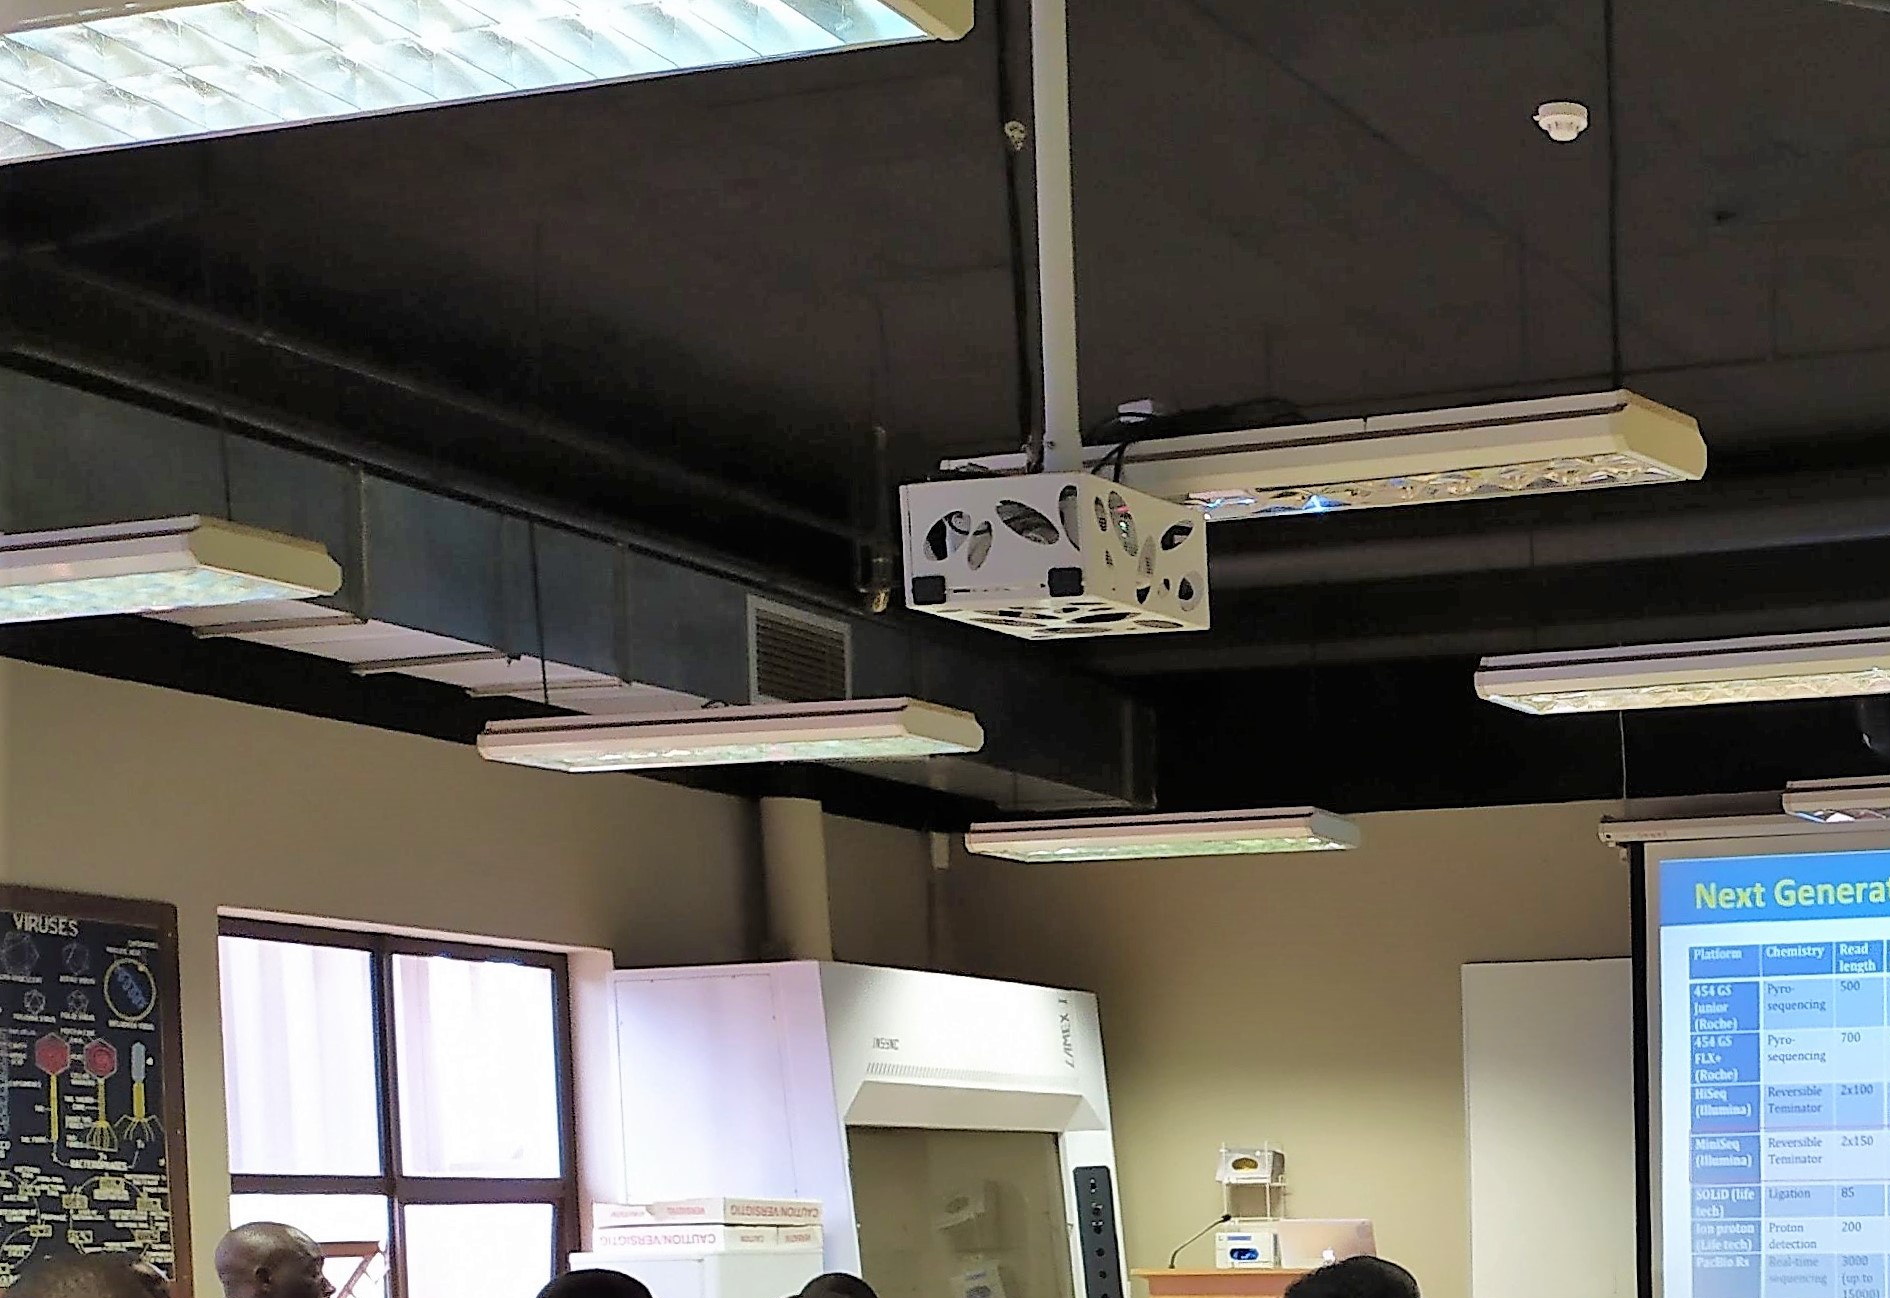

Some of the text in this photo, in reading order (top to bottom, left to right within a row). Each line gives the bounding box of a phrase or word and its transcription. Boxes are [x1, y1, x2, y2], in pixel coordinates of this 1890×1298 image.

[1695, 883, 1766, 910] Next
[13, 912, 79, 937] VIRUSES
[1693, 948, 1743, 960] Platform
[1766, 945, 1825, 959] Chemistry
[1840, 943, 1869, 955] Read
[1840, 960, 1876, 974] length
[1767, 984, 1795, 997] Pyro-
[1840, 980, 1861, 991] 500
[1694, 1002, 1729, 1015] Junior
[1767, 1000, 1826, 1013] sequencing
[1695, 1017, 1738, 1032] (Roche)
[1767, 1035, 1796, 1048] Pyro-
[1841, 1032, 1861, 1043] 700
[1767, 1051, 1826, 1064] sequencing
[1695, 1068, 1738, 1083] (Roche)
[1695, 1088, 1727, 1102] HiSeq
[1768, 1086, 1822, 1098] Reversible
[1841, 1084, 1874, 1096] 2x100
[1695, 1103, 1752, 1118] (Illumina)
[1768, 1102, 1822, 1113] Teminator
[1695, 1138, 1741, 1152] MiniSeq
[1768, 1137, 1823, 1149] Reversible
[1841, 1135, 1873, 1147] 2x150
[1768, 1153, 1823, 1165] Teminator
[1768, 1187, 1811, 1201] Ligation
[1841, 1187, 1855, 1198] 85
[1768, 1222, 1804, 1233] Proton
[1841, 1221, 1862, 1232] 200
[1768, 1238, 1817, 1250] detection
[1769, 1255, 1819, 1267] Real-time
[1841, 1256, 1869, 1267] 3000
[1769, 1273, 1827, 1286] sequencing
[1841, 1272, 1873, 1286] (up to
